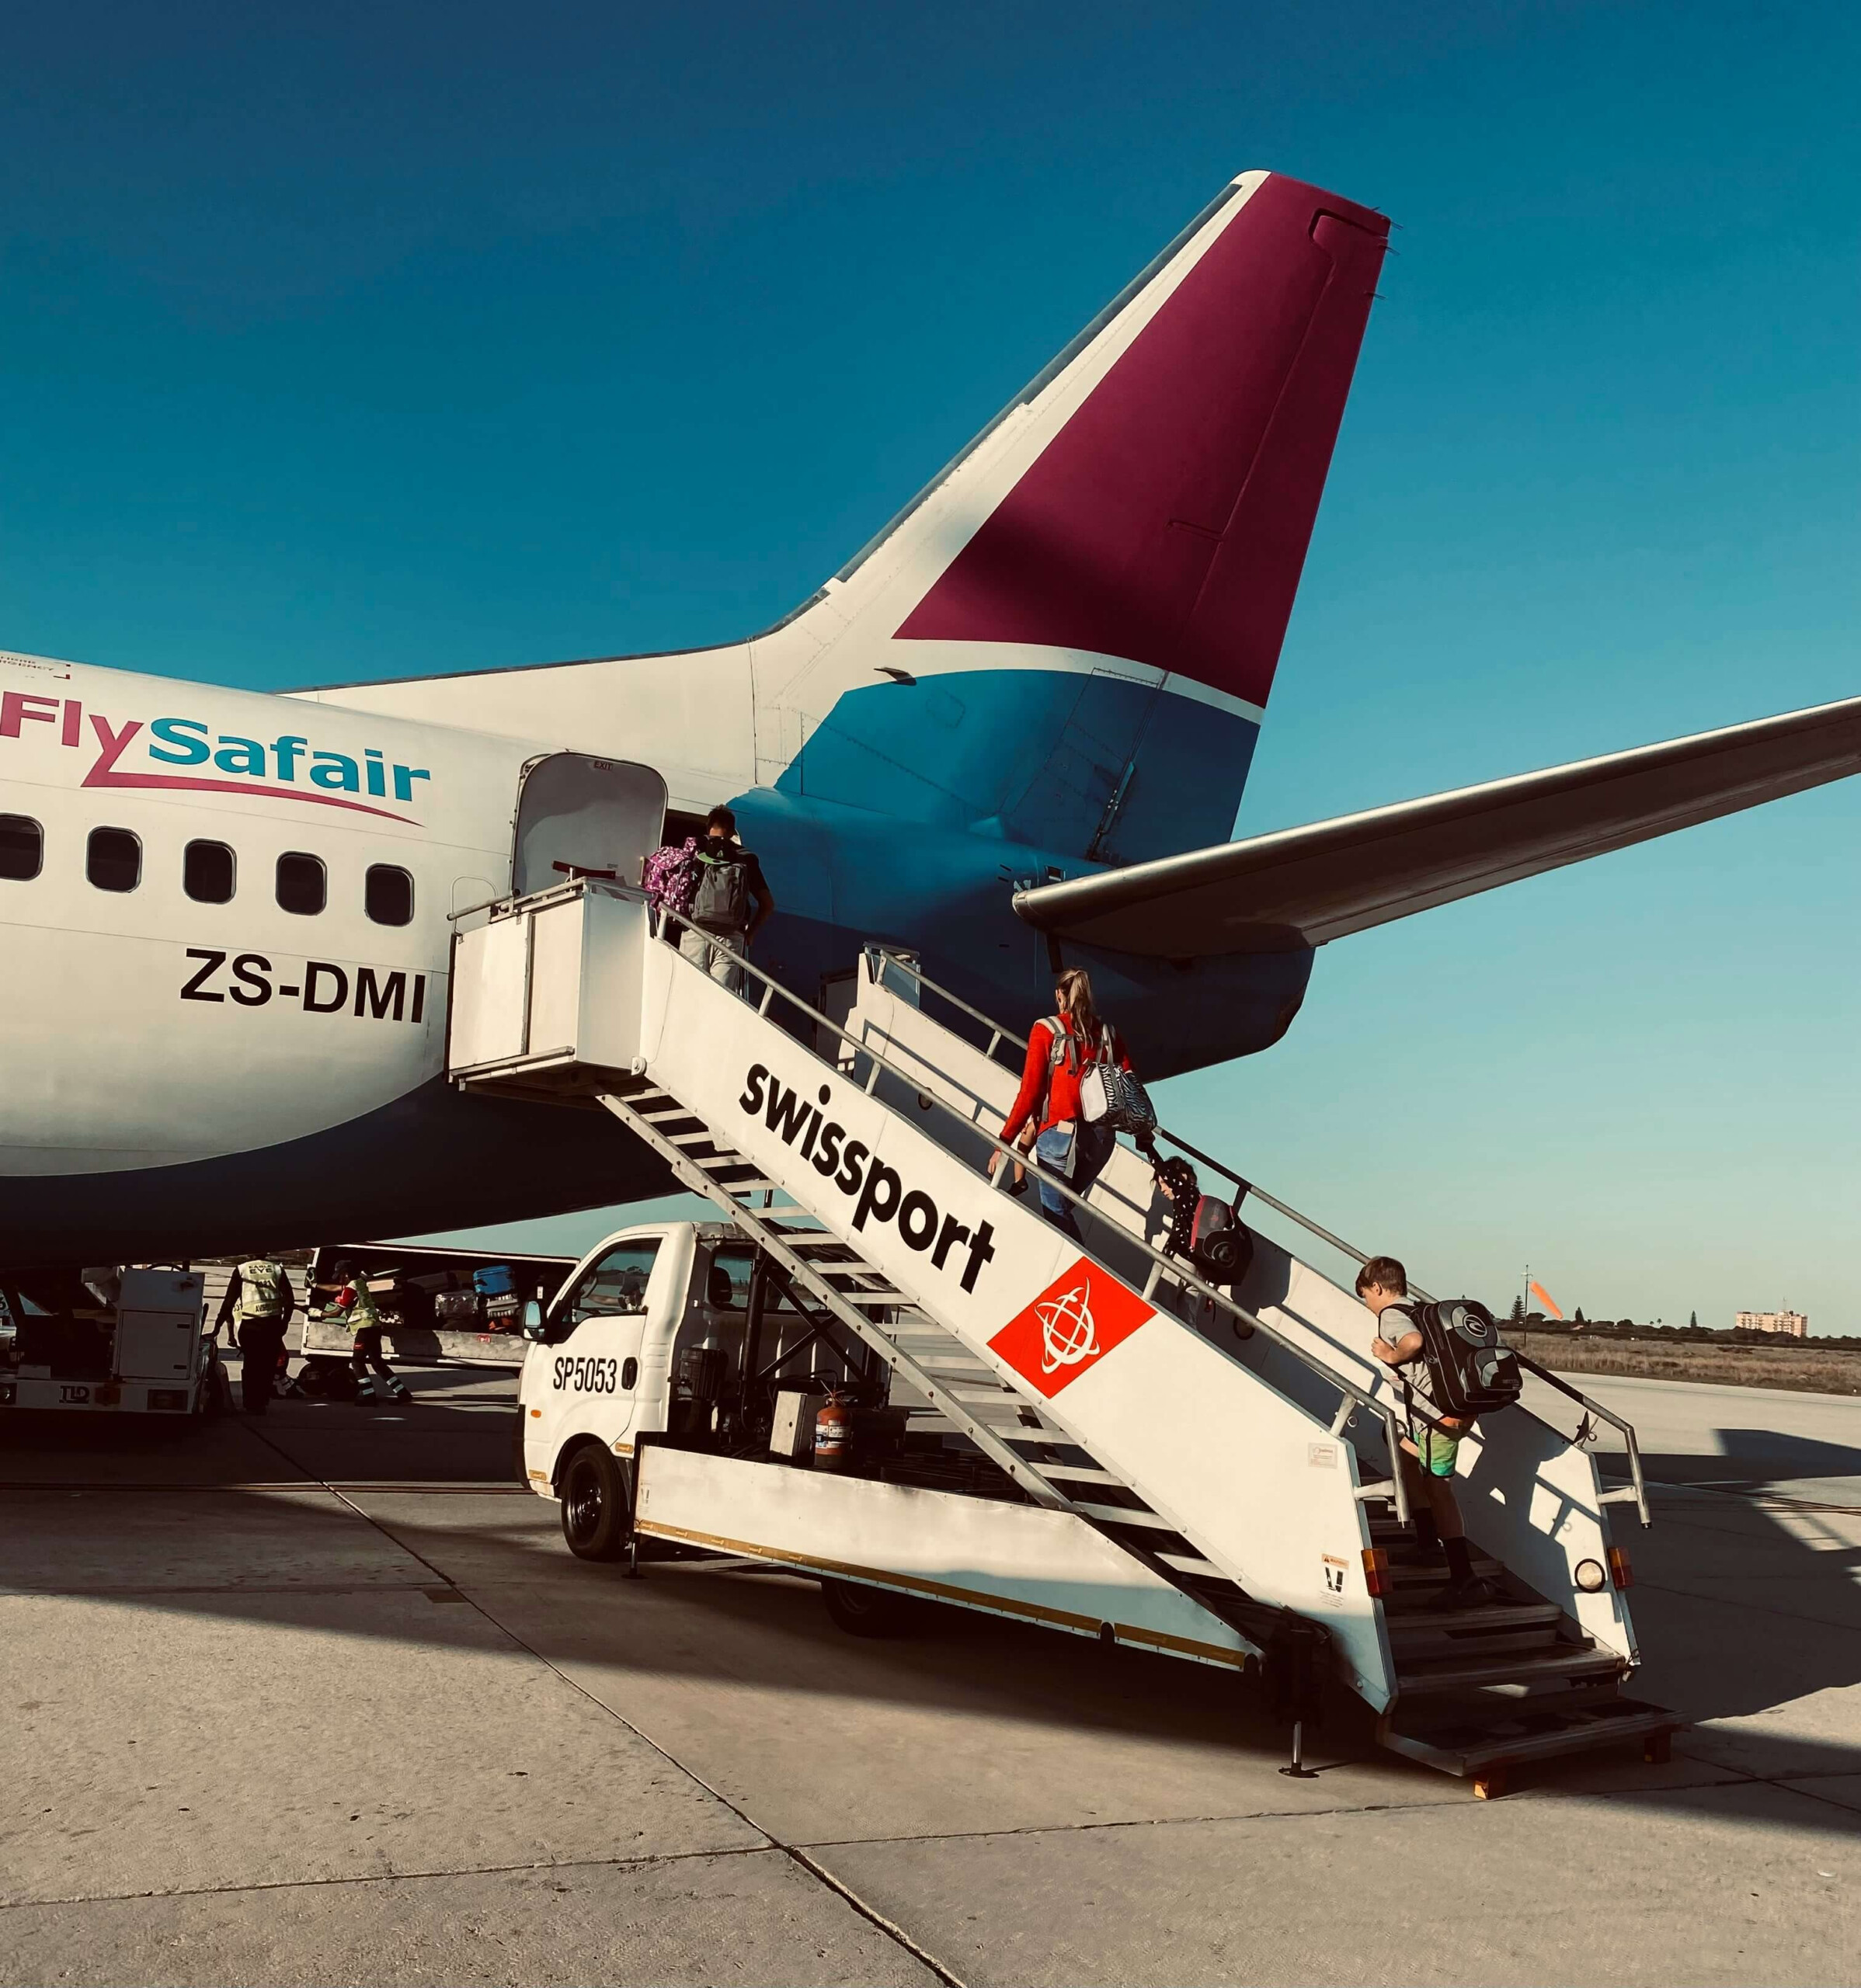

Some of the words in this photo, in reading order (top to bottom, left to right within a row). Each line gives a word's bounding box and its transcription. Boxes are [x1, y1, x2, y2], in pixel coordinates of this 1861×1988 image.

[0, 690, 431, 808] FlySafair
[593, 760, 613, 770] EXIT
[180, 947, 426, 1024] ZS-DMI
[739, 1063, 996, 1295] swissport
[553, 1356, 617, 1394] SP5053
